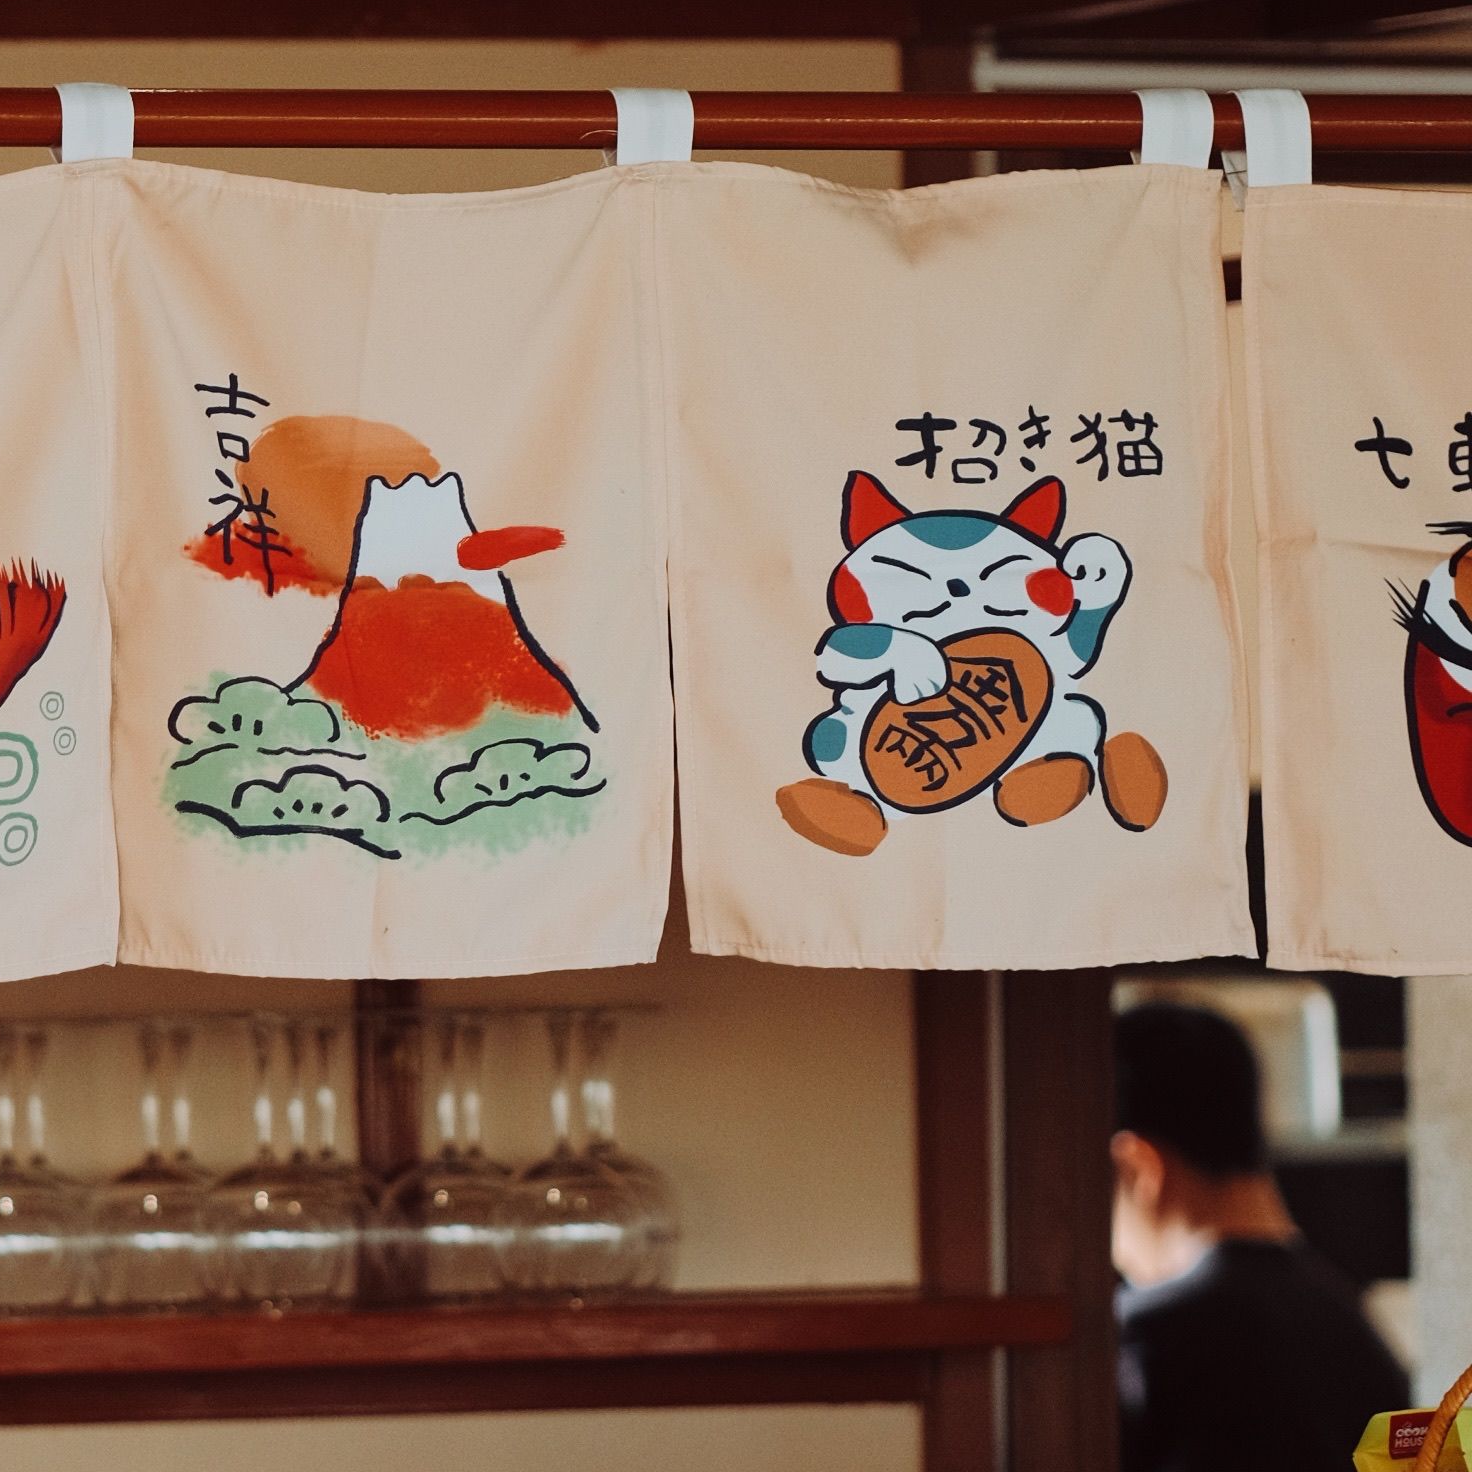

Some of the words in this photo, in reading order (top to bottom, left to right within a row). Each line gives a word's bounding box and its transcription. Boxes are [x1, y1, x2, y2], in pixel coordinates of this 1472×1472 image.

[894, 404, 1163, 484] 招き猫
[194, 372, 294, 597] 吉祥
[1394, 1437, 1425, 1448] HOUS
